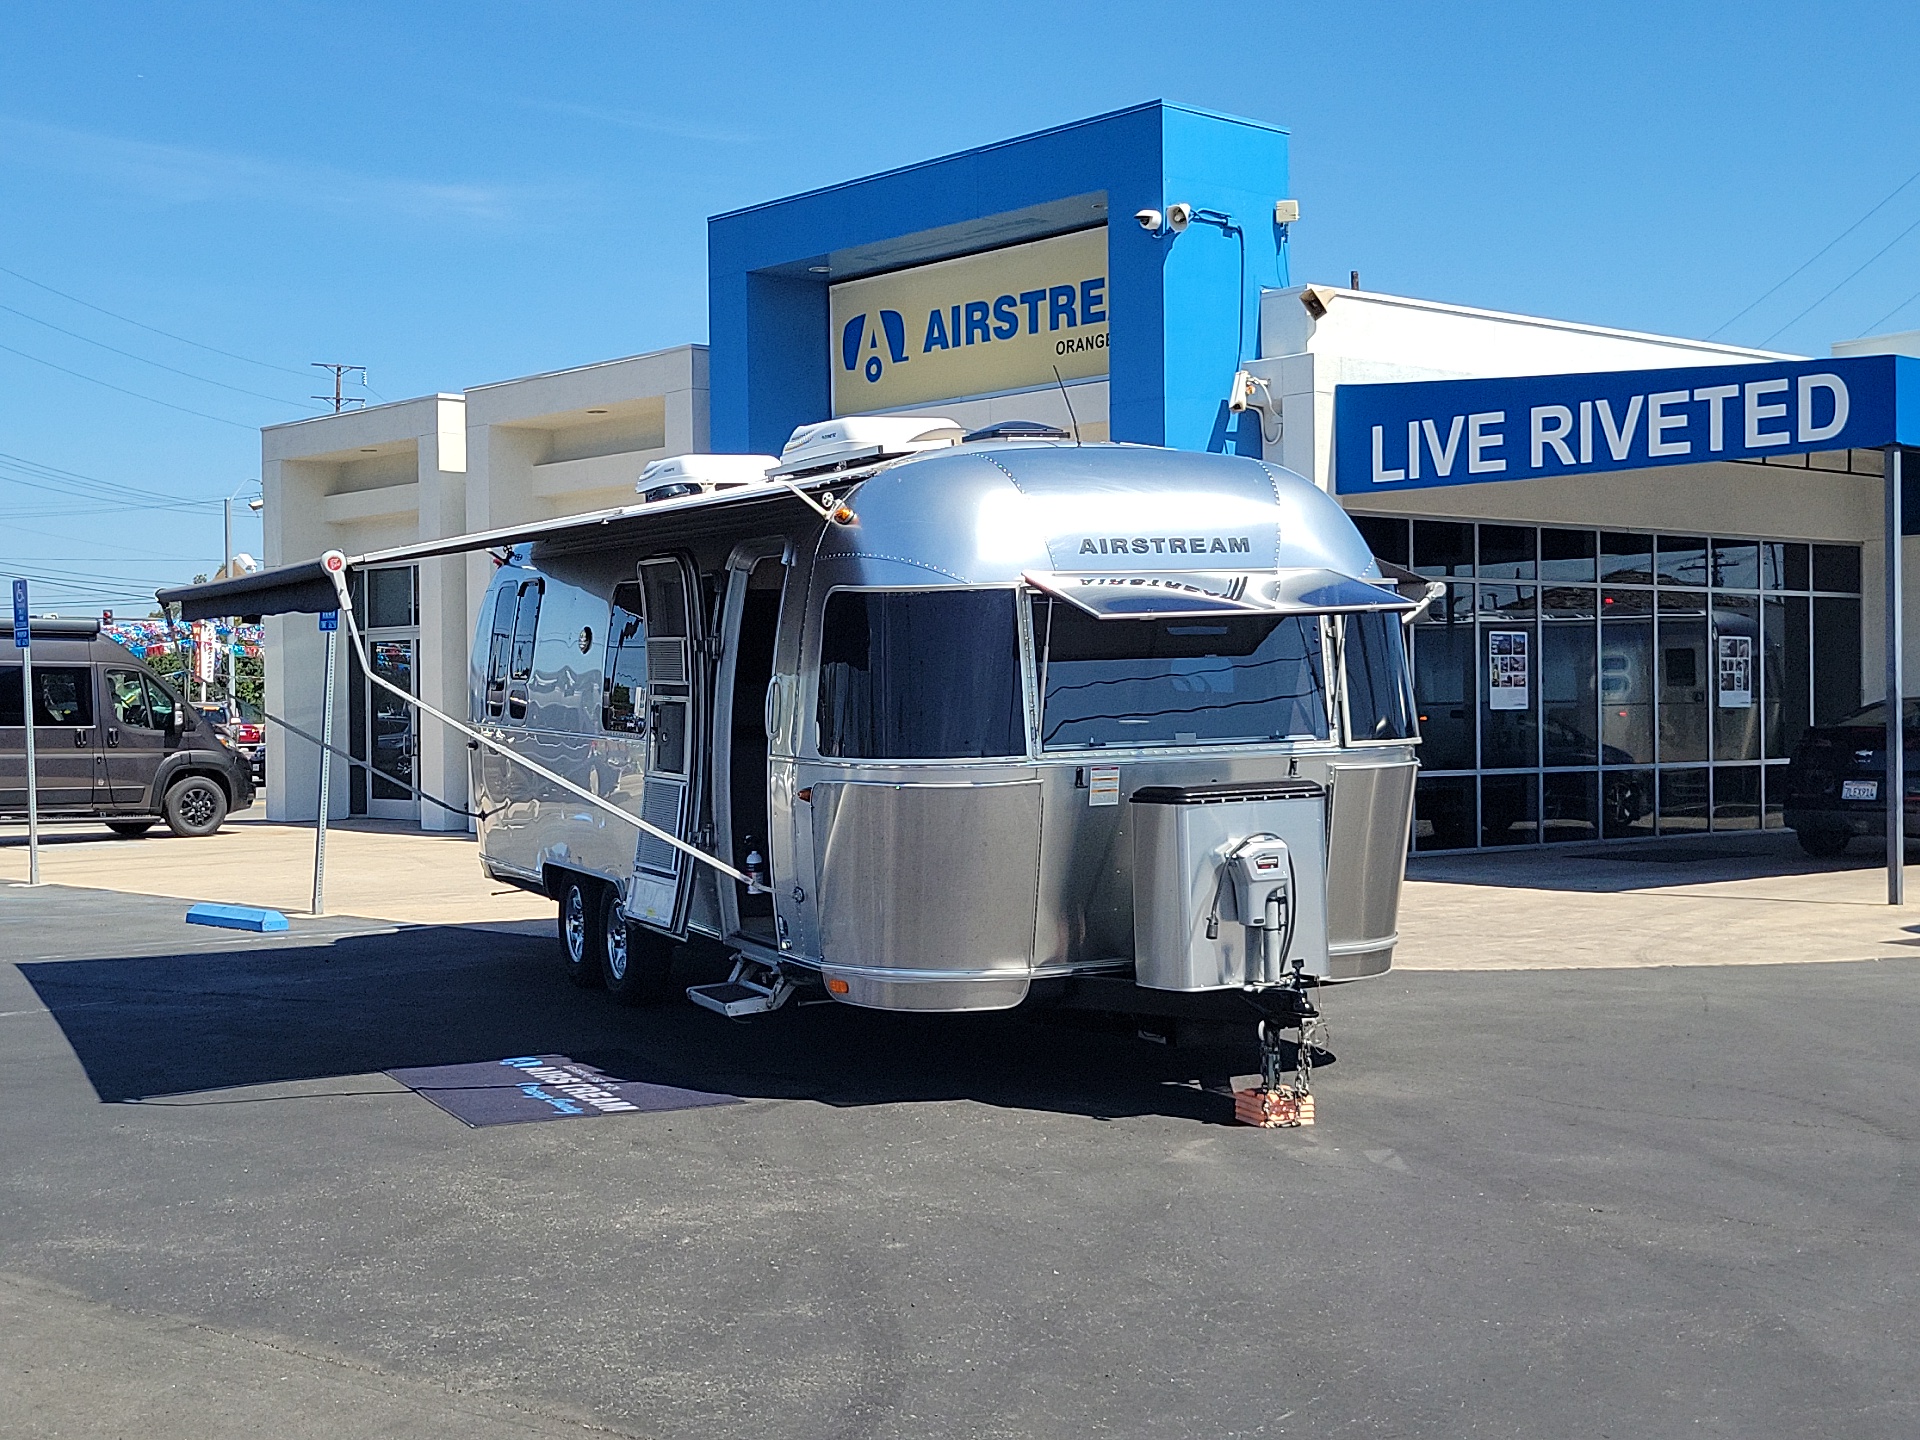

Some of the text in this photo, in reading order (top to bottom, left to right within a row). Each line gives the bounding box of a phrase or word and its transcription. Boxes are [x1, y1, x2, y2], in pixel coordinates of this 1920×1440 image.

[1371, 372, 1850, 483] LIVE RIVETED
[1078, 536, 1251, 555] AIRSTREAM
[519, 1066, 640, 1112] AIRSTREAM
